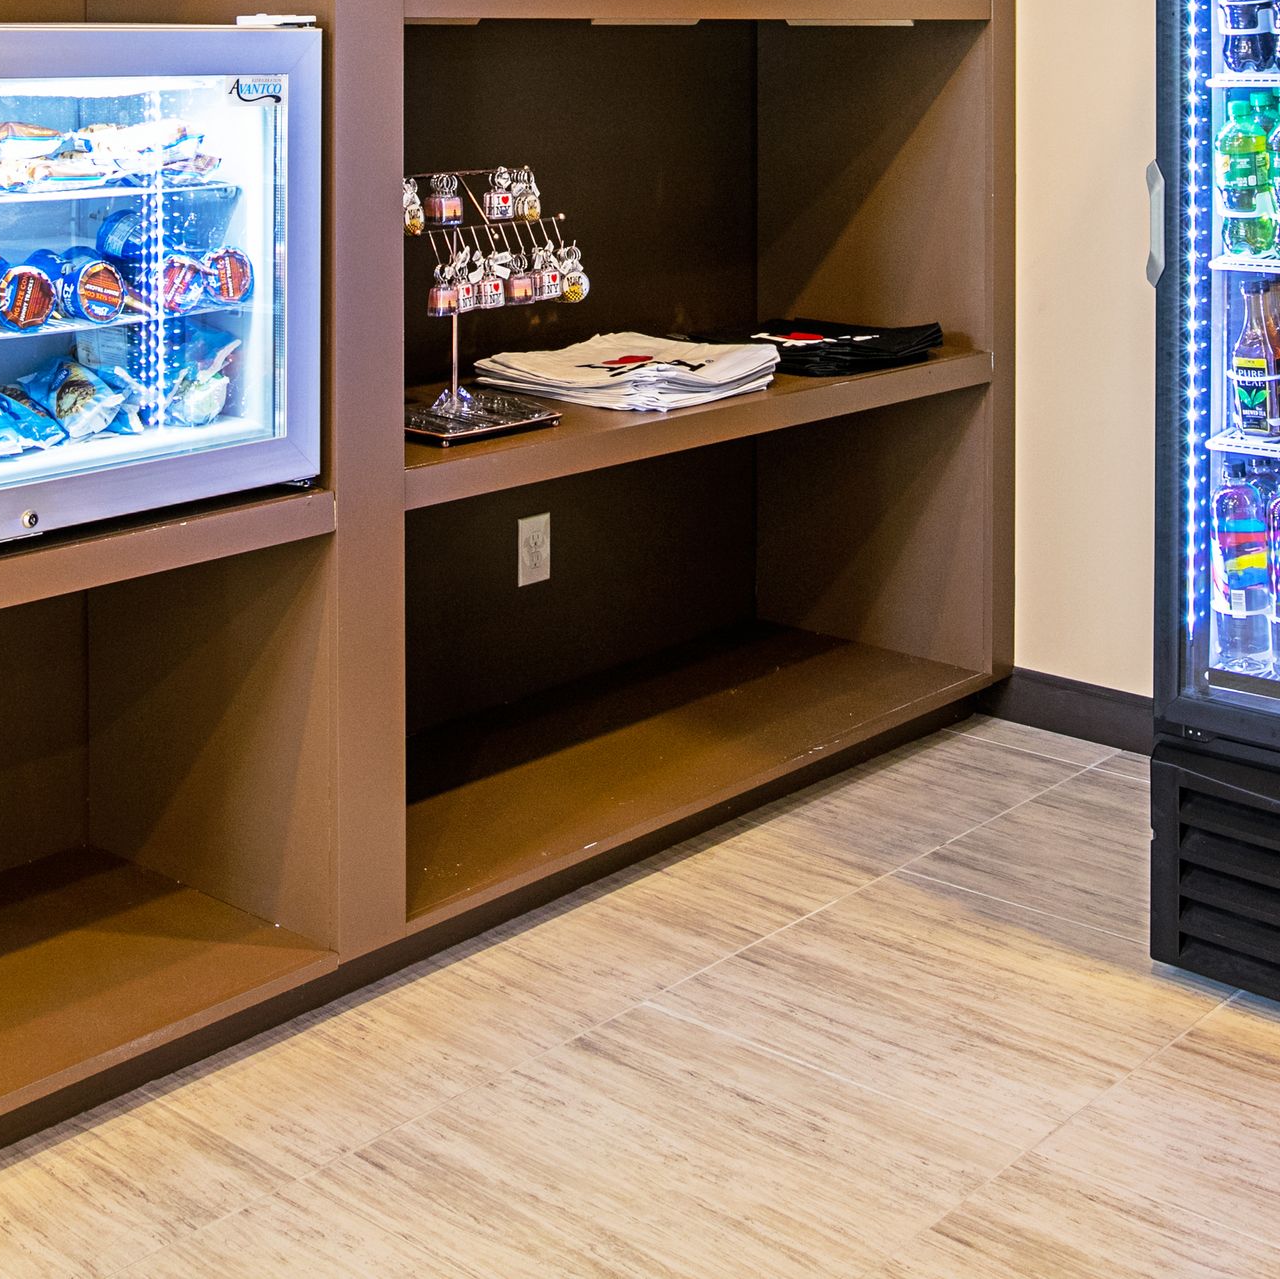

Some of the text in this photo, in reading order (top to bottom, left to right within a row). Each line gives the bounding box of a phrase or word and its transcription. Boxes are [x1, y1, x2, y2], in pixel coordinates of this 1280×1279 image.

[228, 78, 282, 100] AVANTCO
[547, 284, 559, 294] NY
[1238, 369, 1264, 379] PURE
